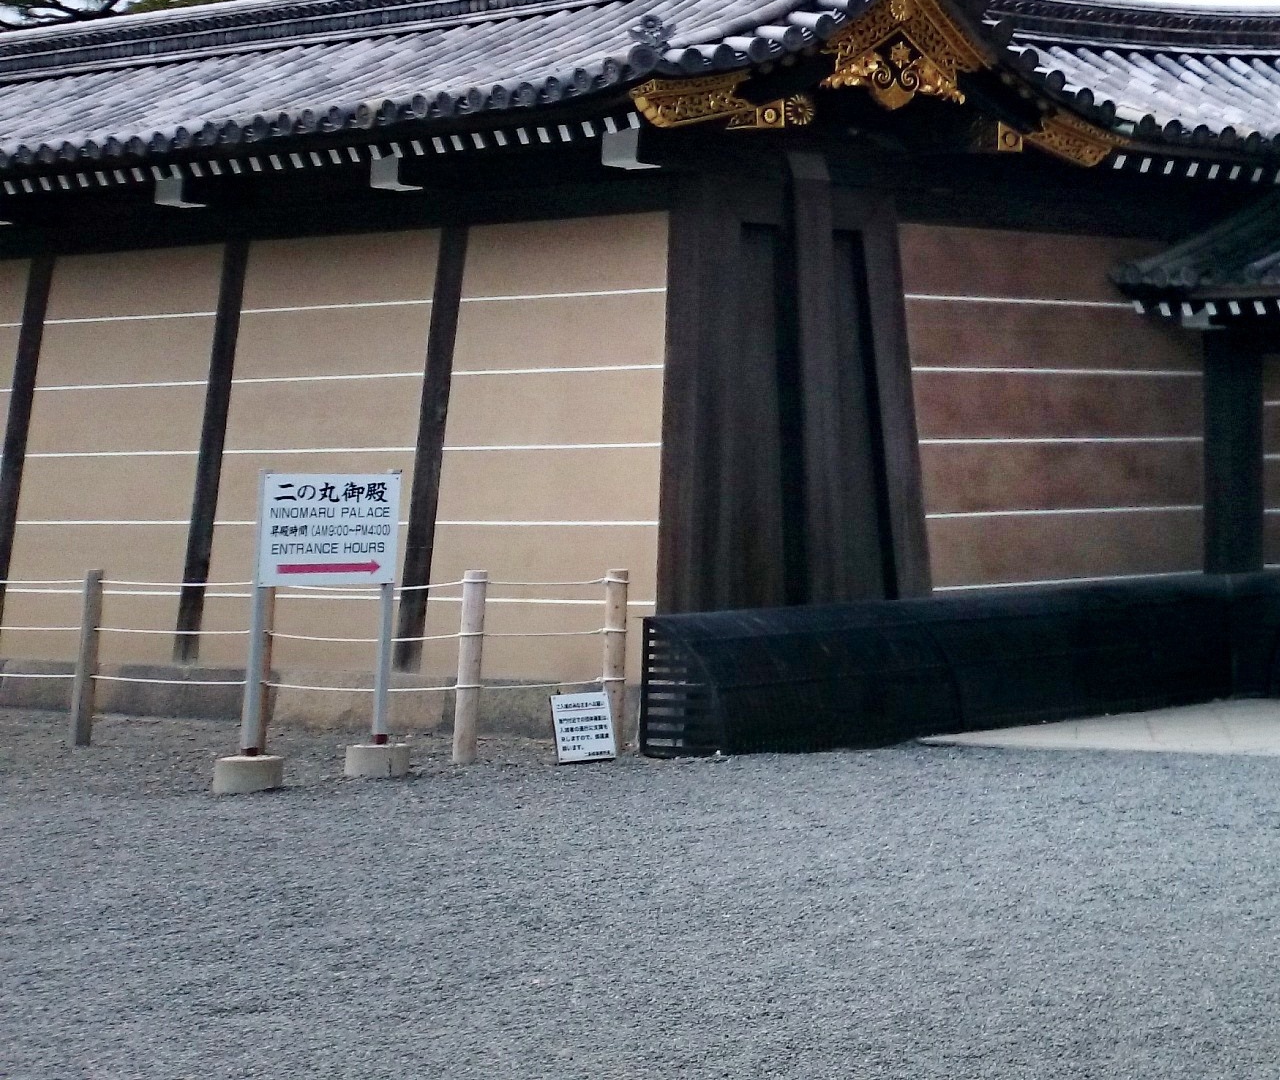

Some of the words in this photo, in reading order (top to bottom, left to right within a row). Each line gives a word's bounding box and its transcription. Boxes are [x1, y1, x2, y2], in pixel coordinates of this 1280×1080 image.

[274, 482, 388, 503] 二の丸御殿
[270, 507, 335, 519] NINOMARU
[341, 506, 390, 518] PALACE
[271, 542, 339, 555] ENTRANCE
[343, 542, 385, 554] HOURS
